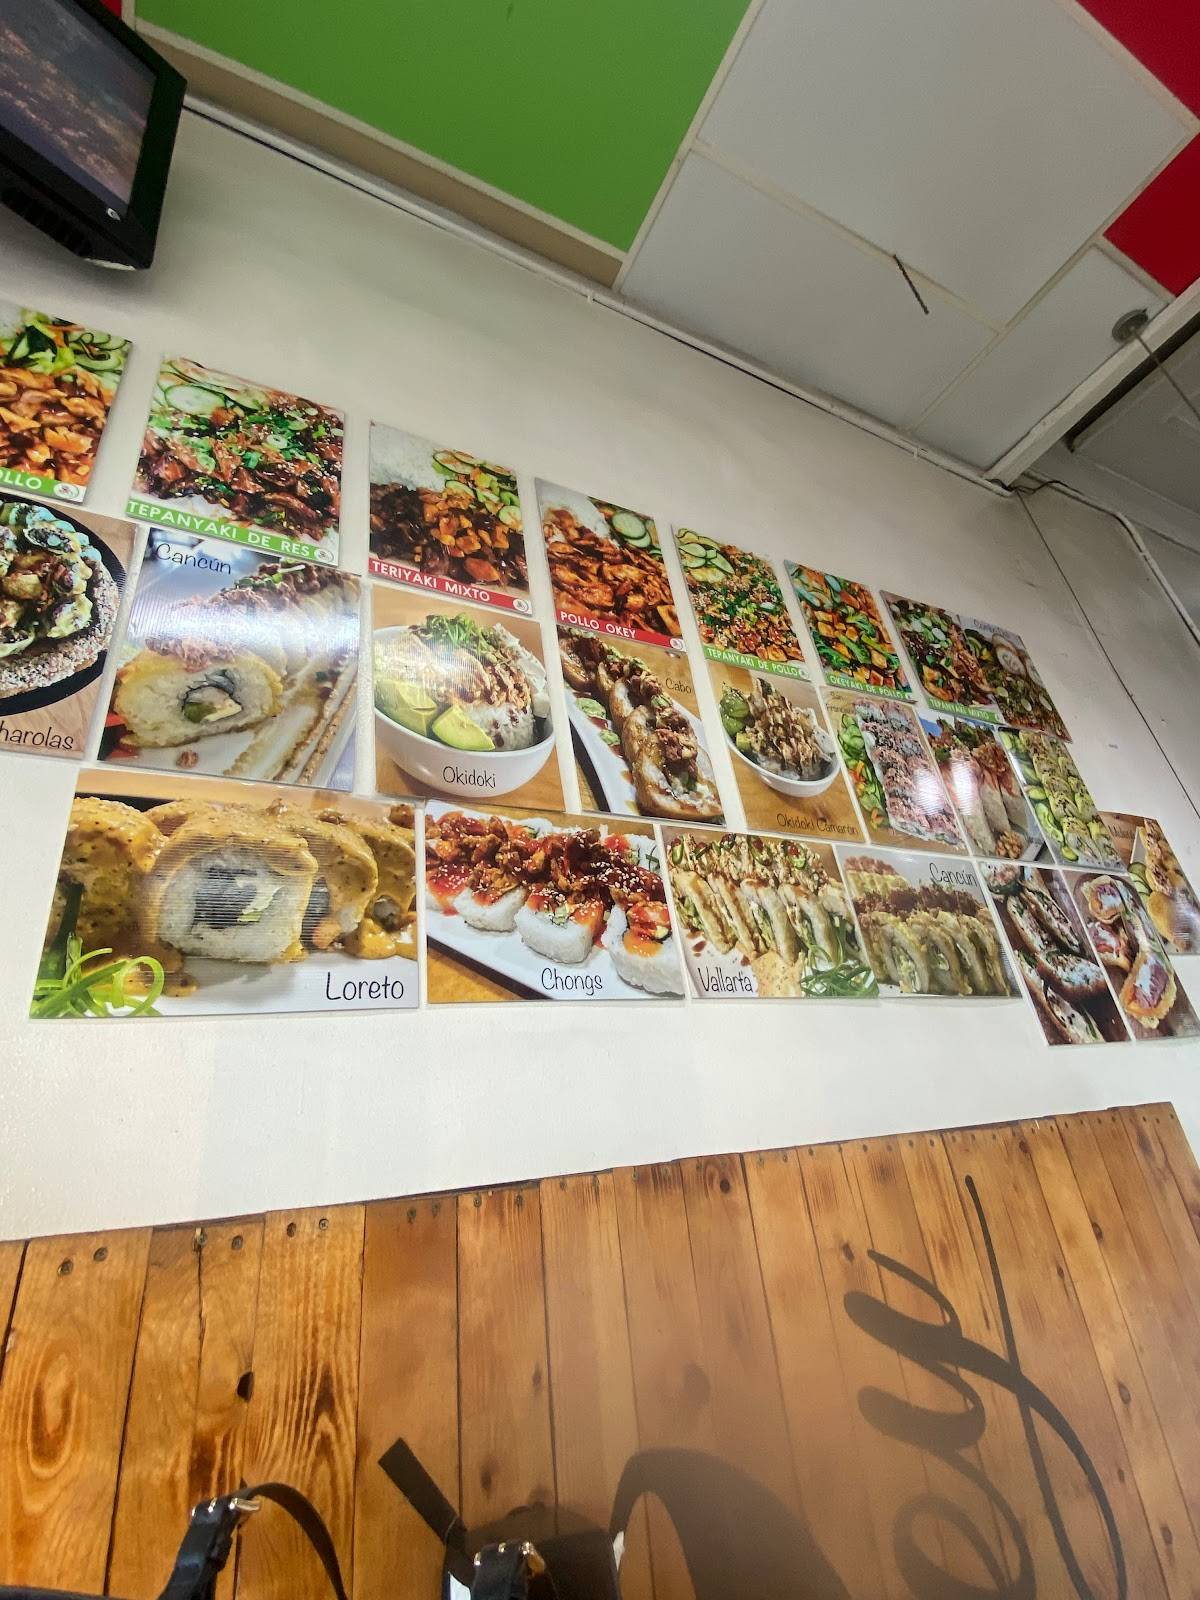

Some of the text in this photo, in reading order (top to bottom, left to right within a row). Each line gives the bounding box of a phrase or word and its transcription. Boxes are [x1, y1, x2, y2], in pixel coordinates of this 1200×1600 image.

[128, 501, 311, 558] TEPANYAKI DE RES
[155, 543, 232, 575] Cancún
[372, 560, 490, 602] TERIYAKI MIXTO
[560, 611, 636, 639] POLLO OKEY
[707, 647, 798, 677] TEPANYAKI DE POLLO
[665, 677, 692, 694] Cabo
[442, 765, 496, 788] Okidoki
[929, 862, 978, 888] Cancún
[325, 971, 404, 1001] Loreto
[541, 967, 604, 996] Chongs
[697, 966, 754, 993] Vallarta
